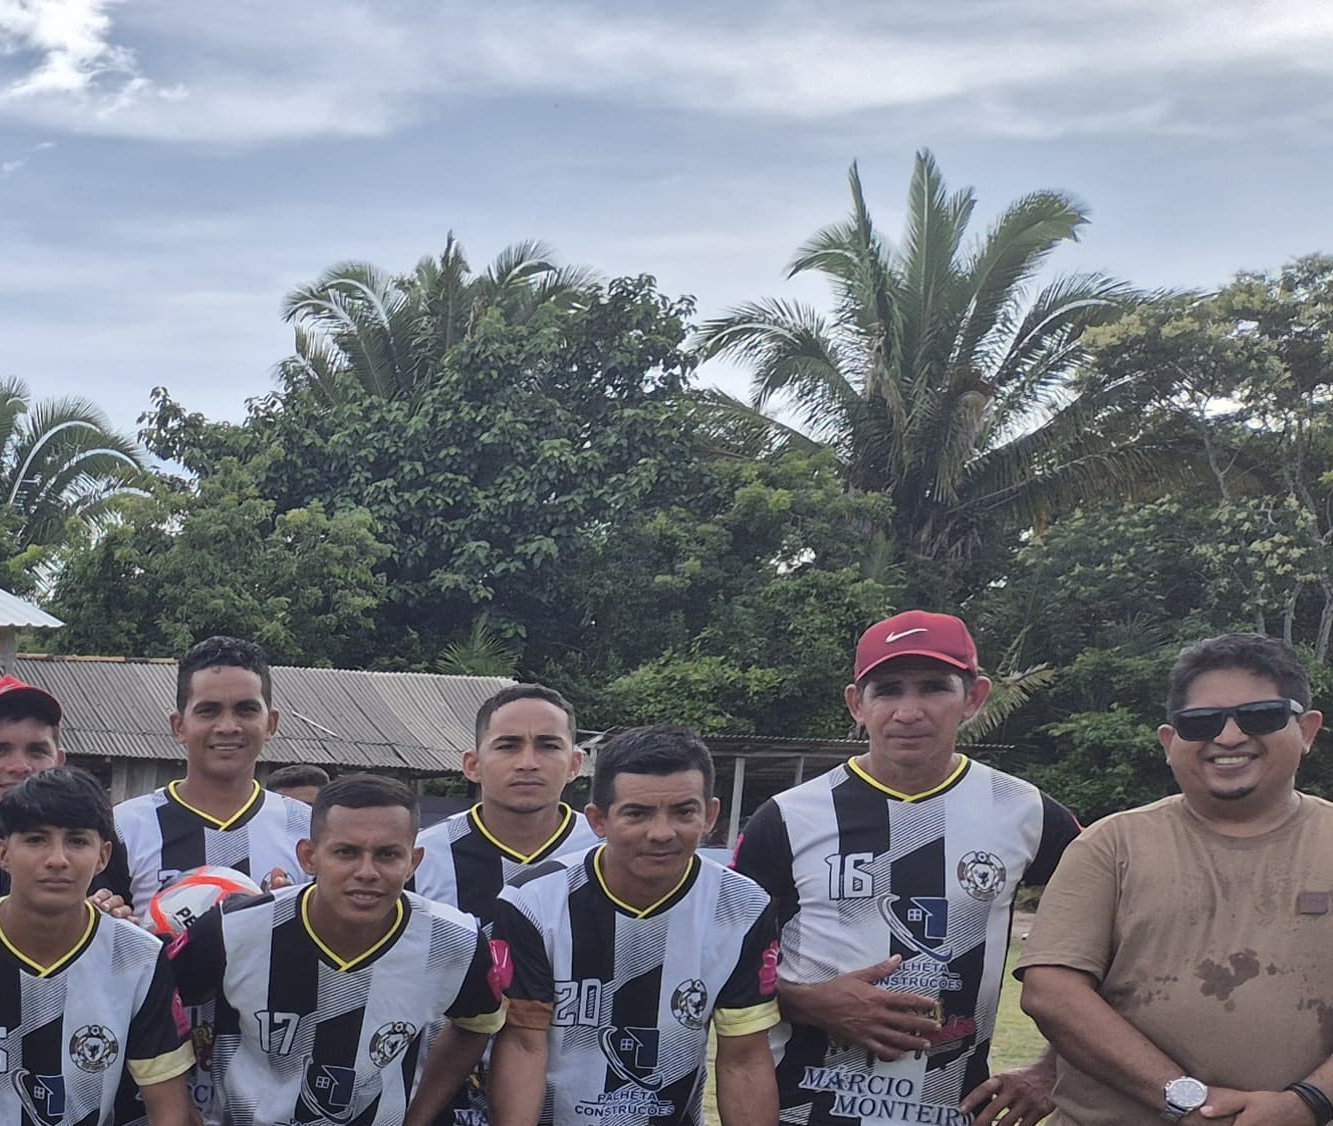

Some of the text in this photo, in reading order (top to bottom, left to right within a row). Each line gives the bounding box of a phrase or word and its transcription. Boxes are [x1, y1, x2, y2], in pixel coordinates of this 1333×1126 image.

[824, 852, 878, 900] 16
[893, 962, 948, 973] ALHETA
[554, 977, 602, 1028] 20
[254, 1009, 300, 1056] 17
[803, 1065, 914, 1098] MÁRCIO
